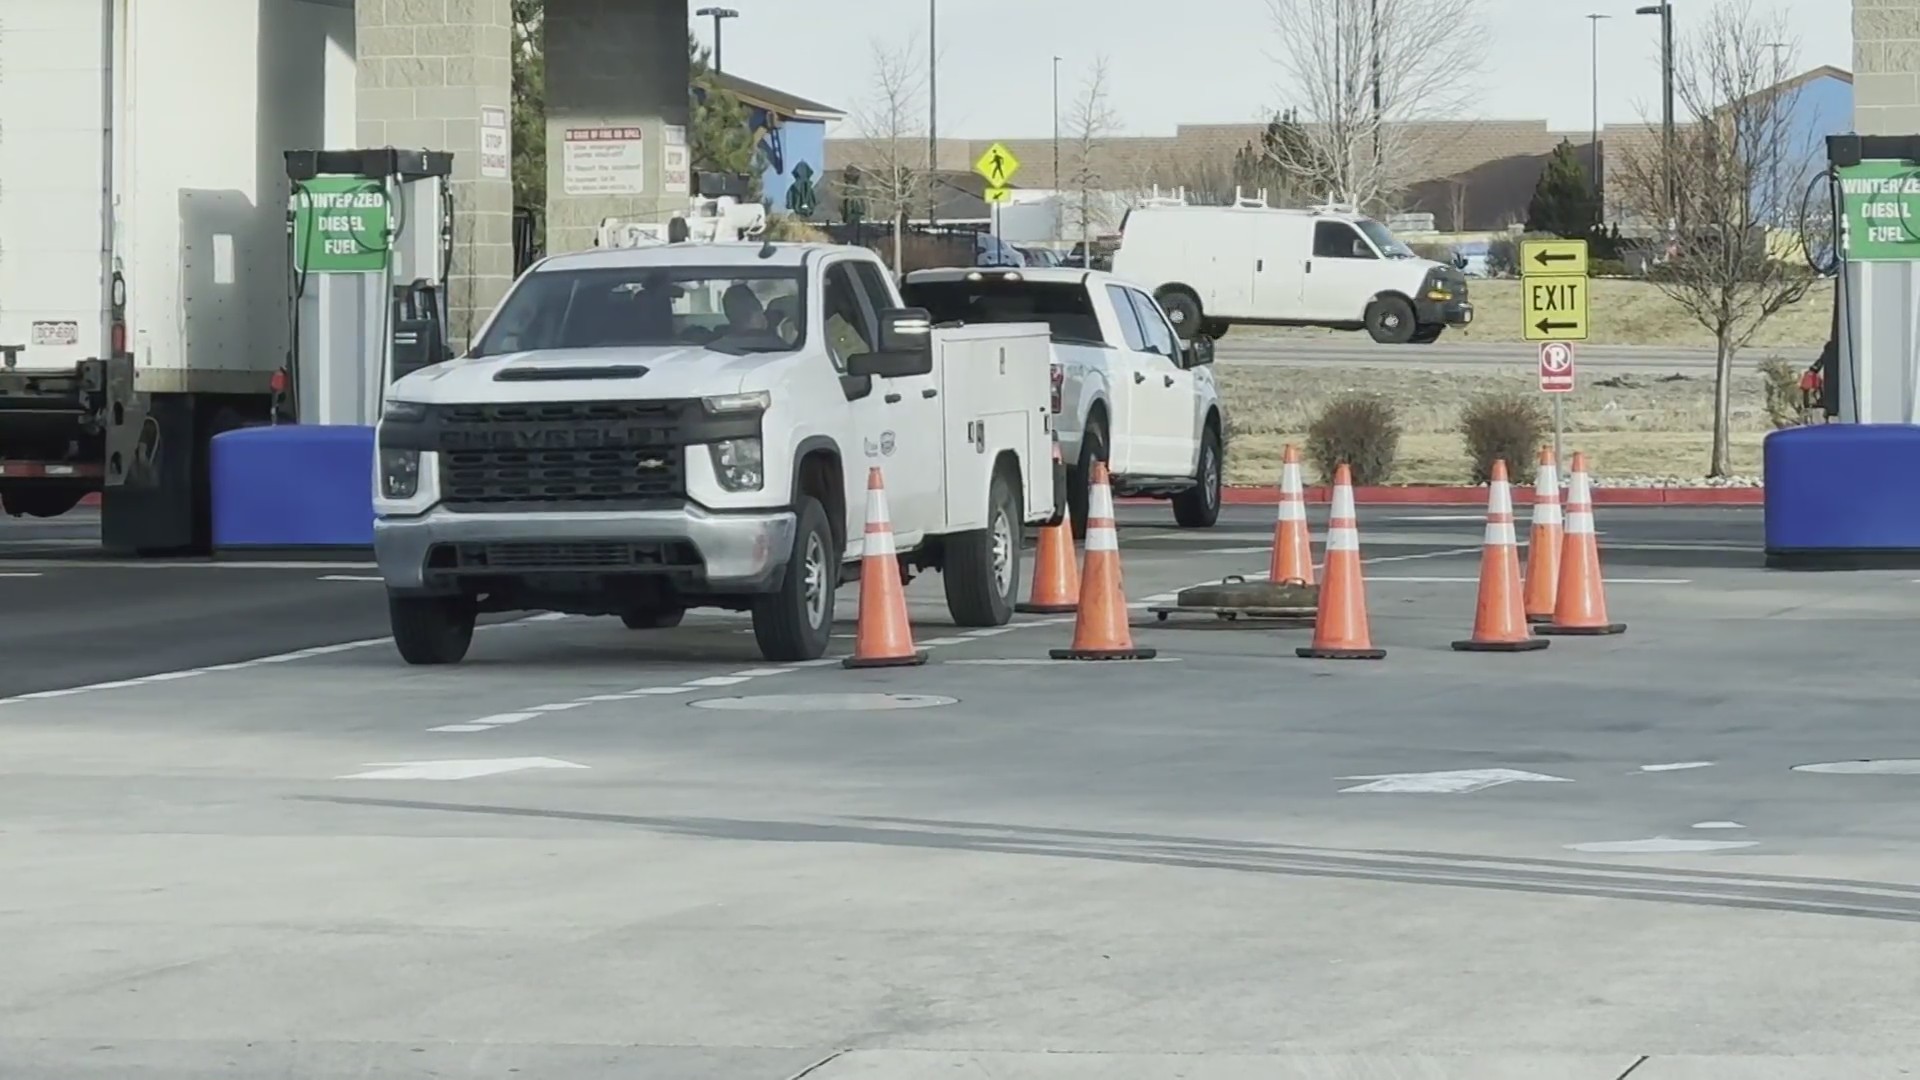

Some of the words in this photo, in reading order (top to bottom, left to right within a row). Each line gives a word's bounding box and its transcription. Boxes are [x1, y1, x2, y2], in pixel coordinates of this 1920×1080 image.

[482, 153, 505, 168] ENGINE
[301, 193, 384, 208] WINTERIZED
[1861, 202, 1911, 218] DIESEL
[318, 216, 365, 231] DIESEL
[1868, 226, 1905, 242] FUEL
[324, 239, 359, 254] FUEL
[1533, 285, 1577, 311] EXIT
[439, 427, 678, 448] CHEVROLET
